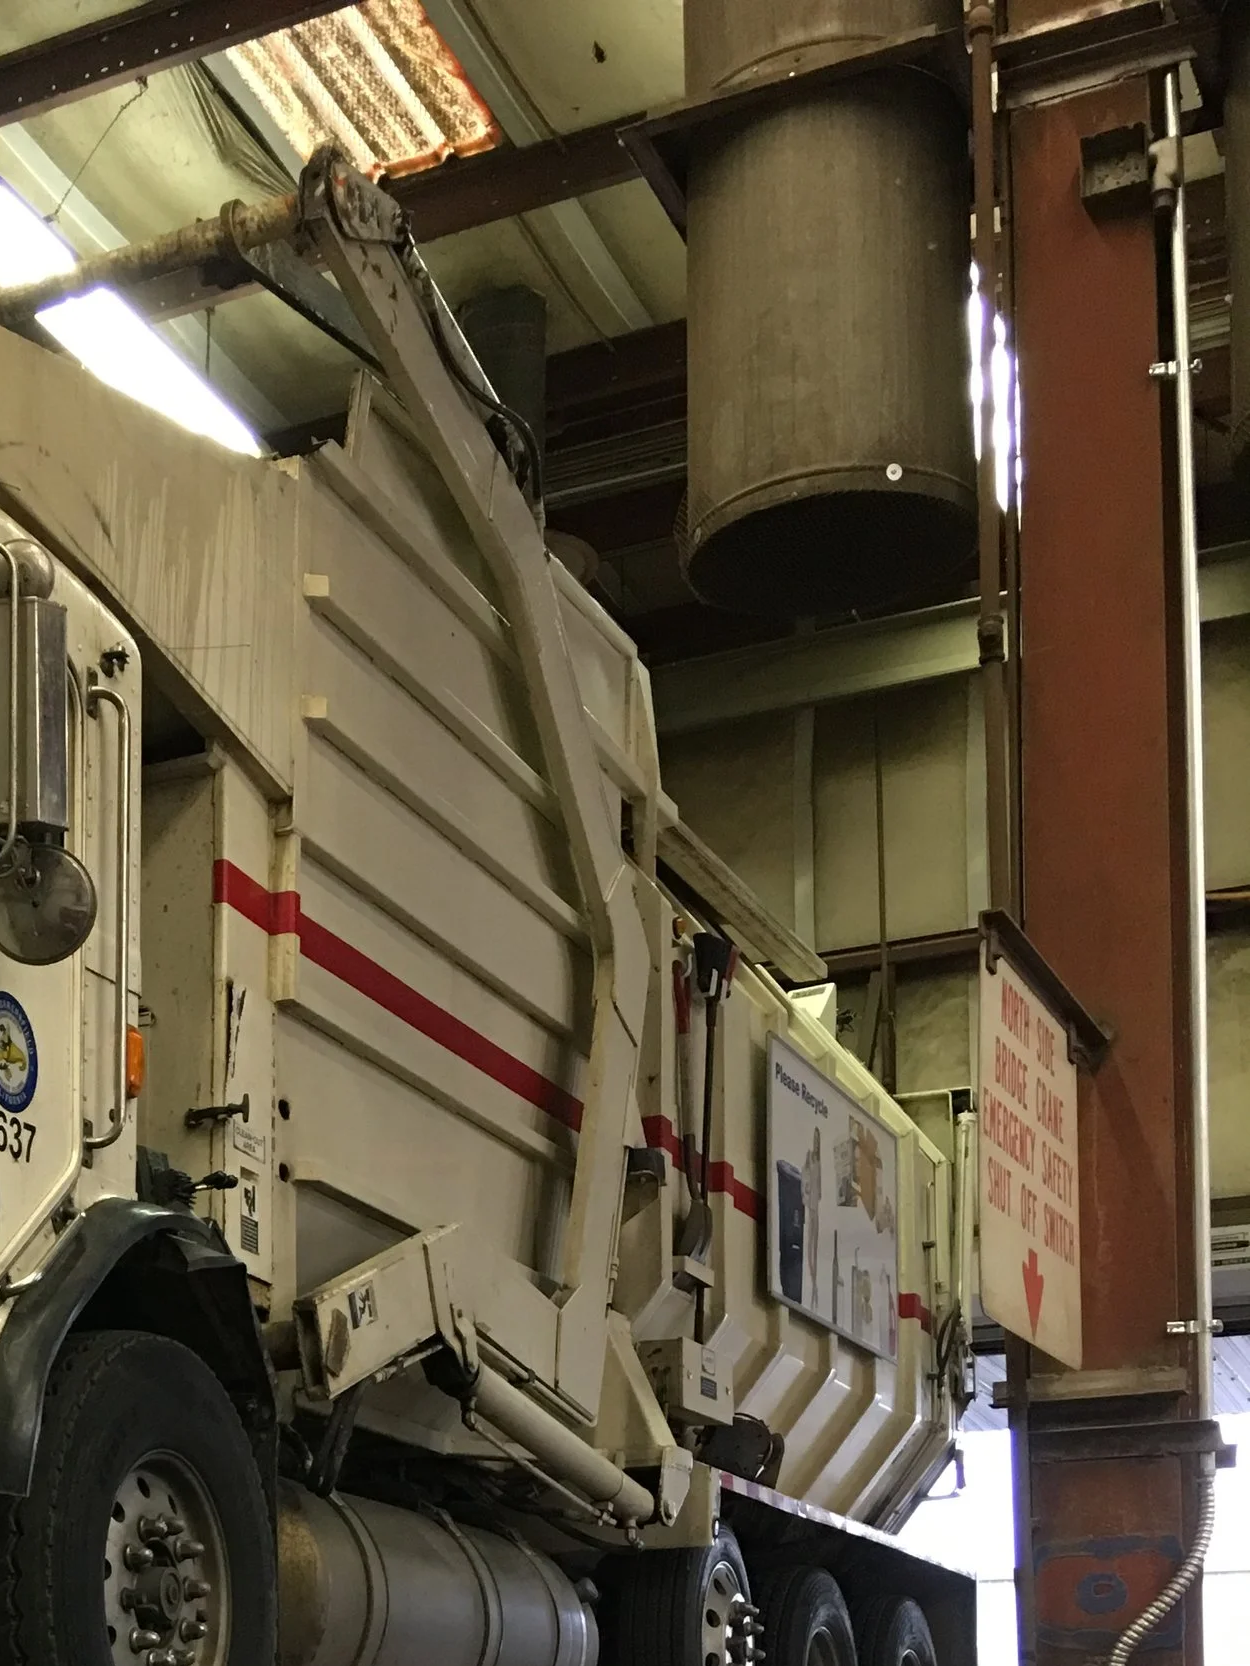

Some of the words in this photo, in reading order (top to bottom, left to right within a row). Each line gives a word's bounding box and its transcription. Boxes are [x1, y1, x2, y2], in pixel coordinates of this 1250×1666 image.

[1001, 977, 1030, 1049] NORTH
[1036, 1016, 1055, 1077] SIDE
[775, 1061, 800, 1097] Please
[801, 1082, 829, 1120] Recycle
[995, 1035, 1028, 1110] BRIDGE
[1035, 1076, 1064, 1145] CRANE
[983, 1086, 1036, 1176] EMERGENCY
[1041, 1140, 1073, 1209] SAFETY
[987, 1155, 1012, 1217] SHUT
[1020, 1182, 1038, 1237] OFF
[1043, 1202, 1075, 1267] SWITCH
